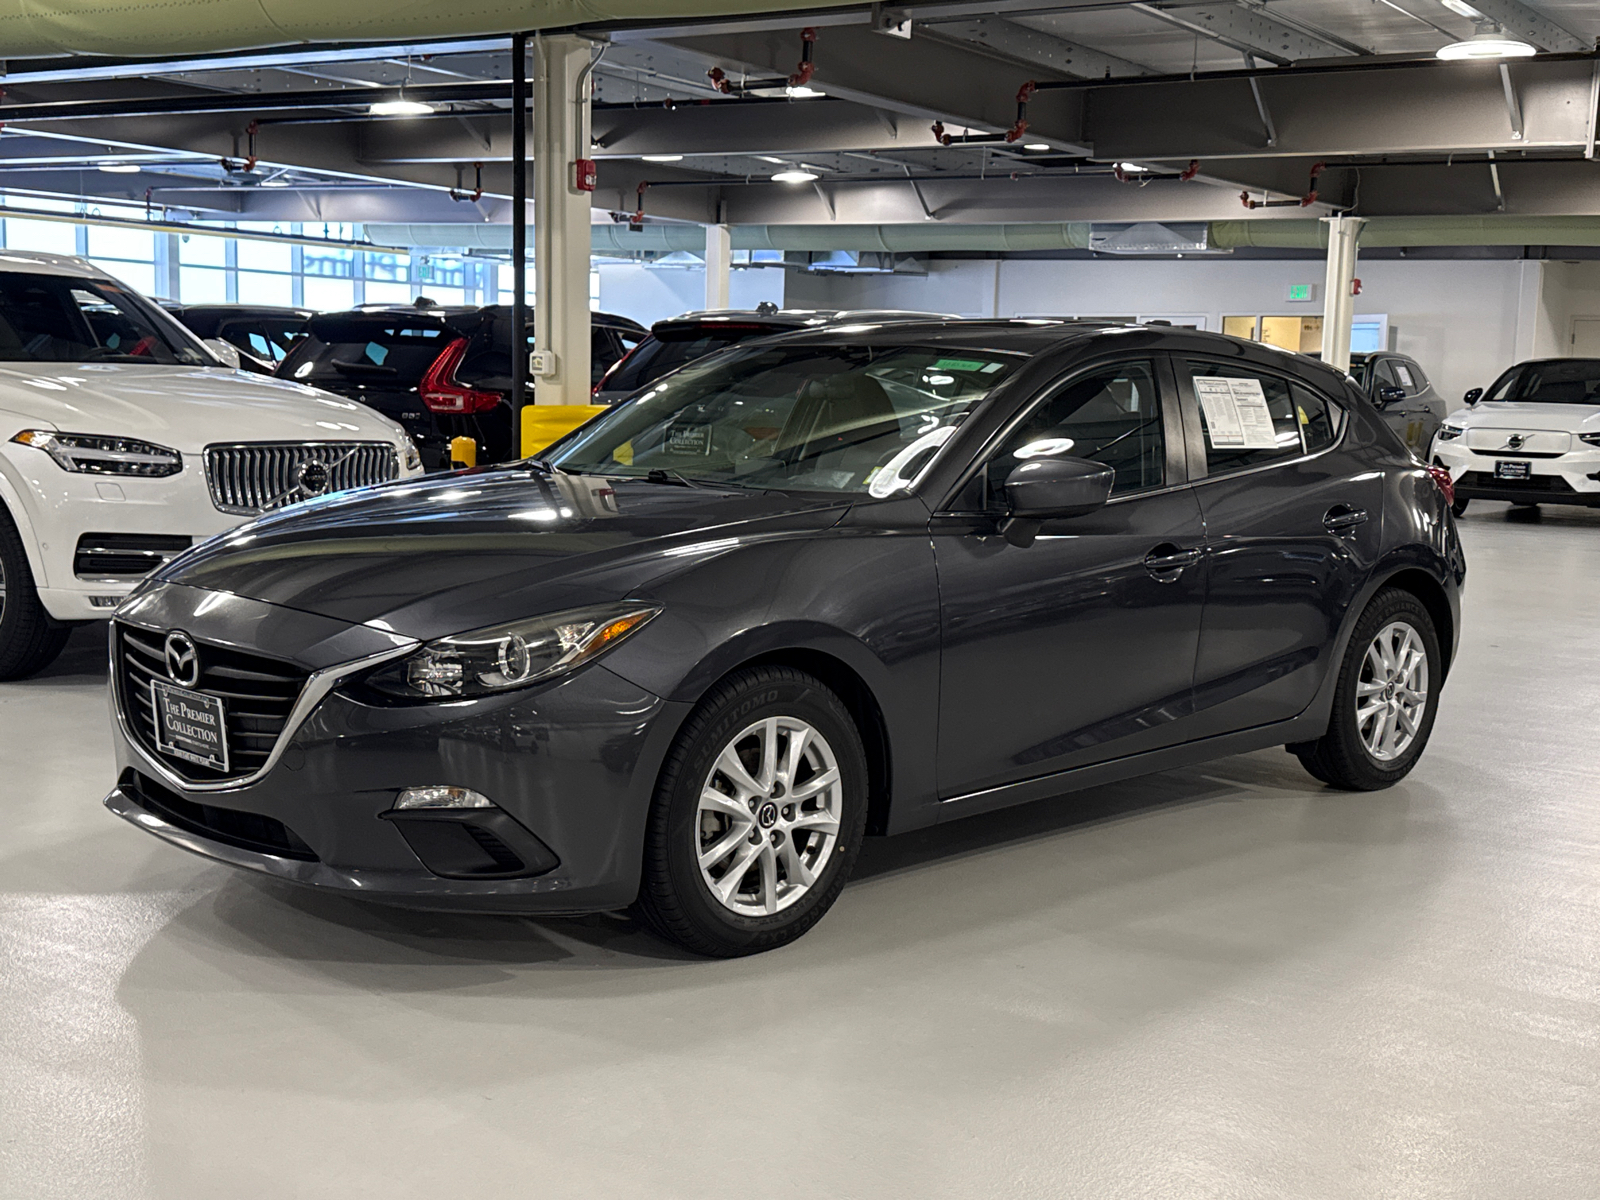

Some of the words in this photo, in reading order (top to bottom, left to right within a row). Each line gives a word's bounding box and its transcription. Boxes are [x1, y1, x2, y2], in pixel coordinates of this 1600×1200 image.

[1290, 284, 1308, 299] EXIT
[163, 697, 180, 716] THE
[180, 702, 216, 726] PREMIER
[166, 714, 218, 744] COLLECTION
[693, 690, 779, 775] SUMITOMO
